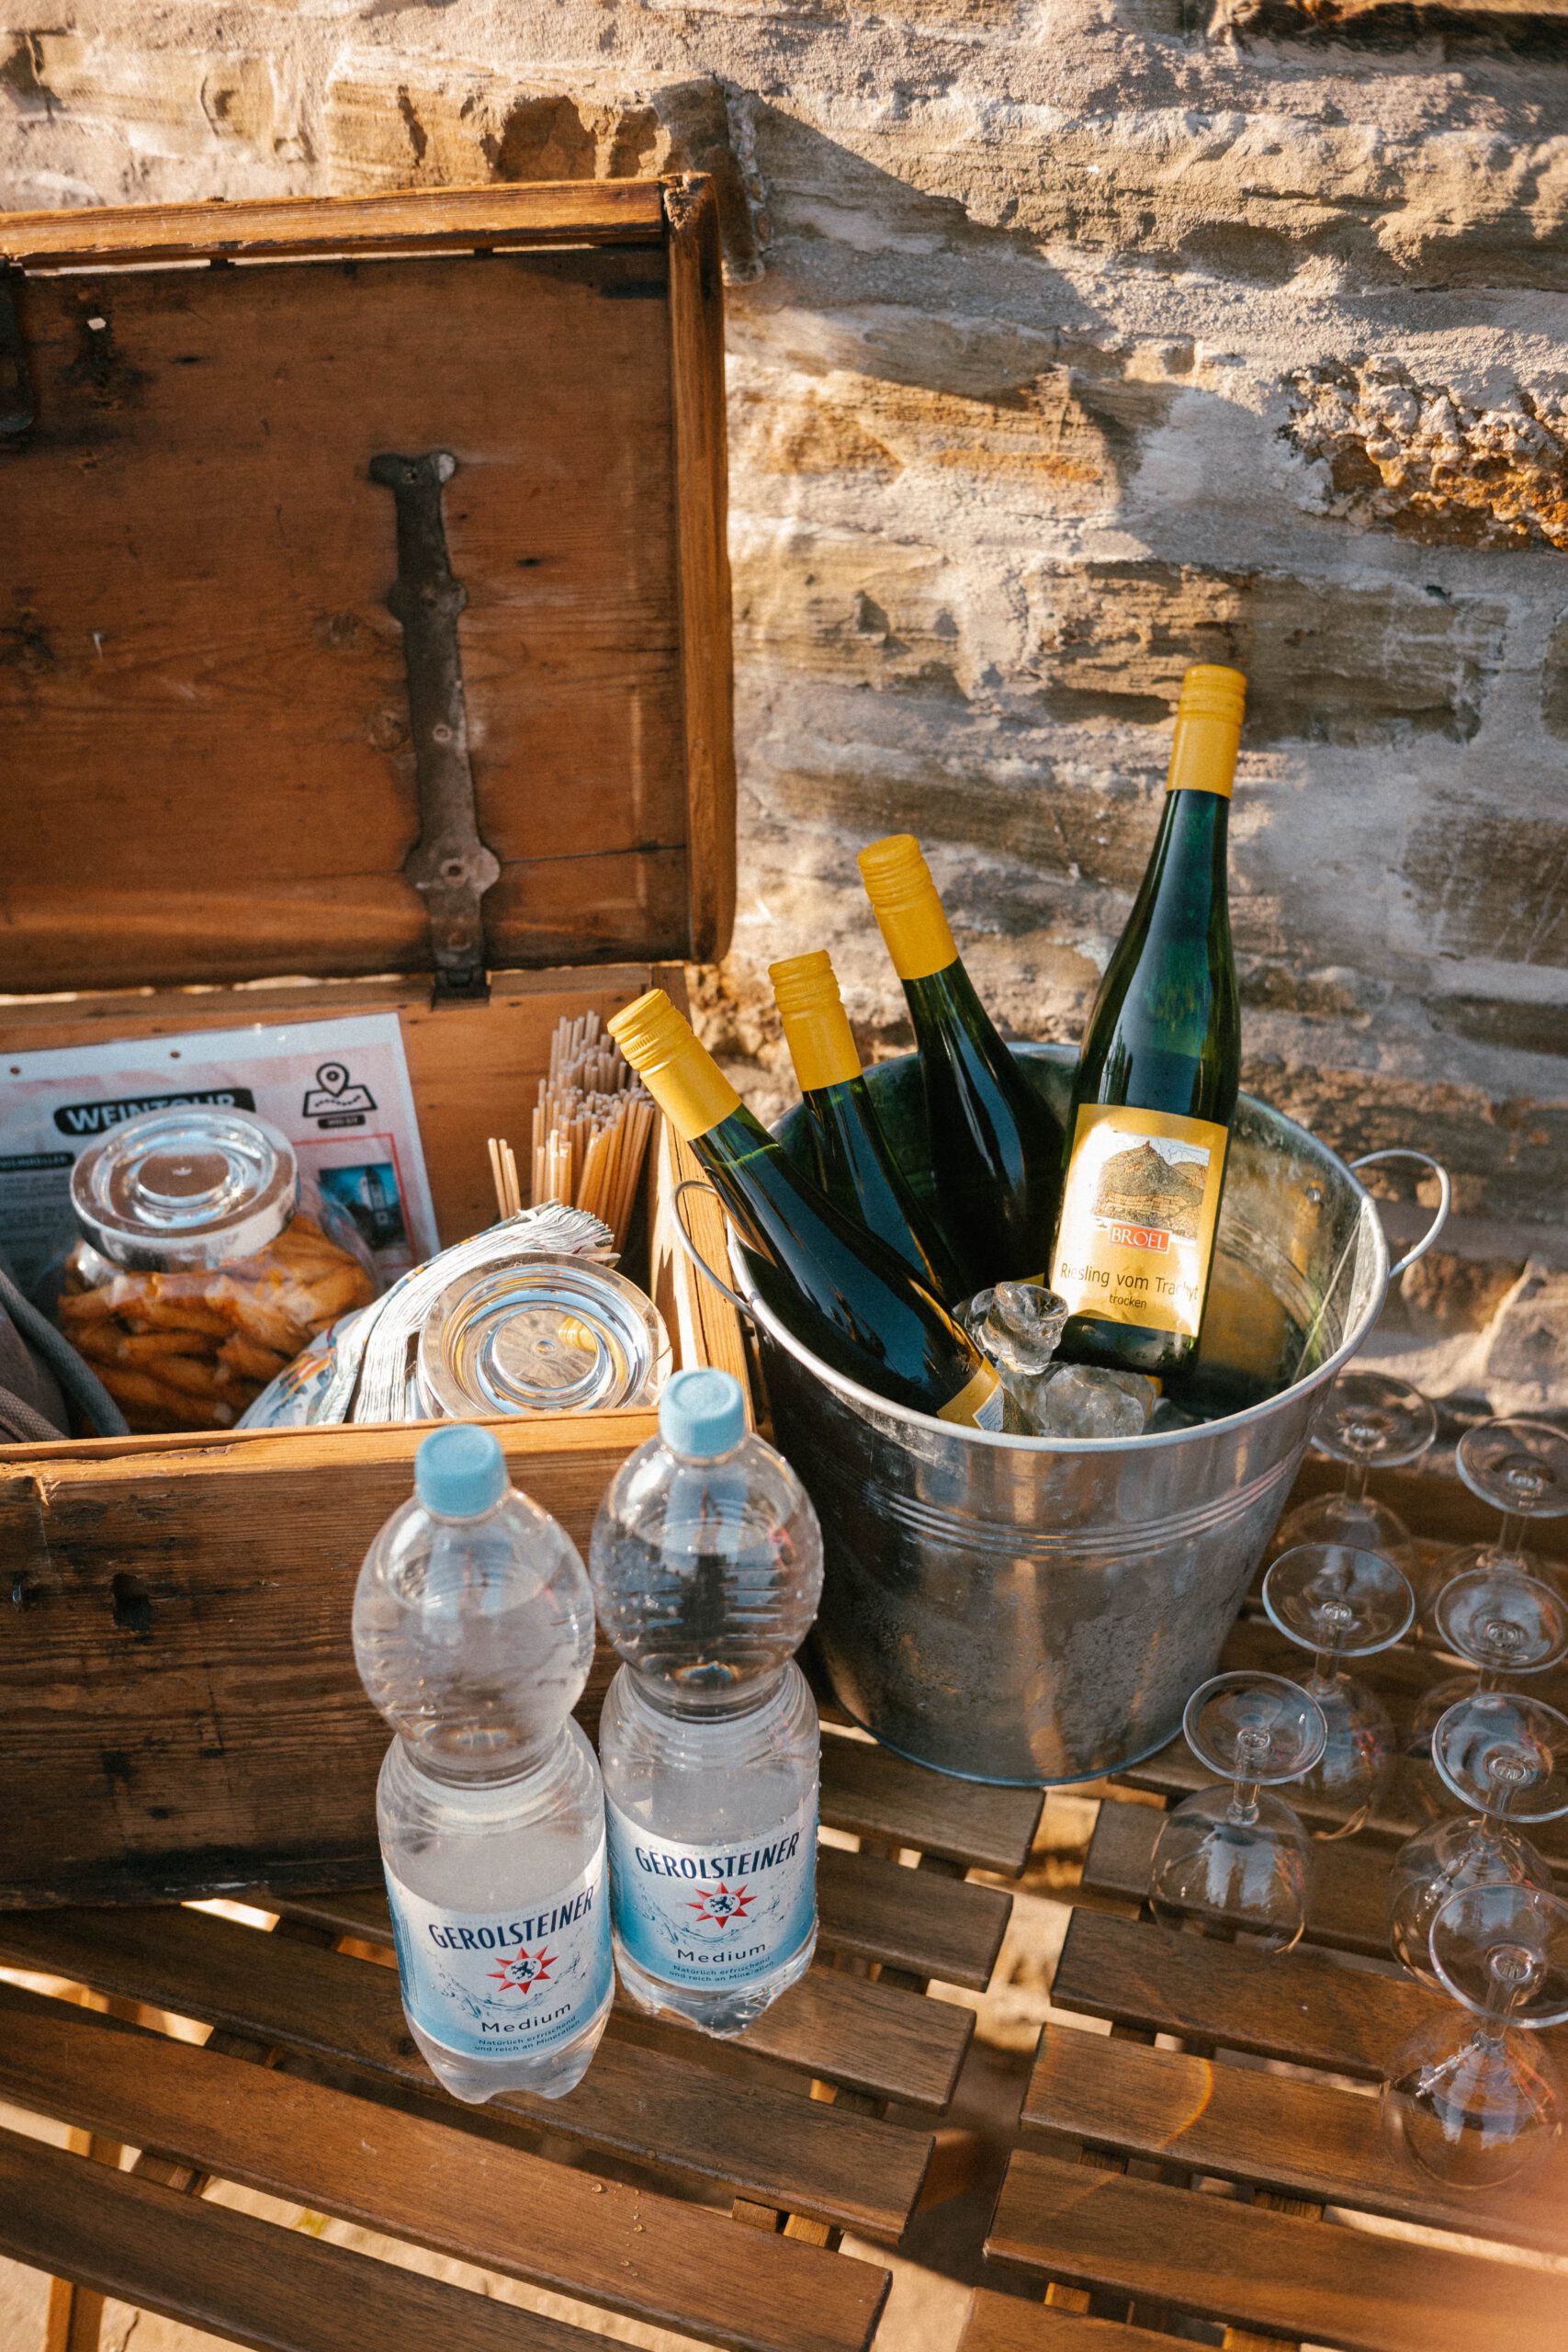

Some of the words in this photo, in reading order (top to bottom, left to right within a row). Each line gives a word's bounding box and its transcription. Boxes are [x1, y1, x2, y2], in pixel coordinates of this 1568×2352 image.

[1111, 1227, 1167, 1250] BROEL
[1060, 1262, 1111, 1288] Riesling
[1116, 1273, 1149, 1291] vom
[1109, 1293, 1147, 1309] trocken
[636, 1831, 800, 1880] GEROLSTEINER
[428, 1885, 594, 1950] GEROLSTEINER
[673, 1964, 716, 1975] Natürlich
[719, 1955, 771, 1974] erfrischend
[677, 1943, 766, 1963] Medium
[669, 1970, 686, 1979] und
[479, 2038, 524, 2046] Natürlich
[526, 2015, 576, 2041] erfrischend
[481, 2003, 571, 2033] Medium
[536, 2019, 581, 2046] Mineralien
